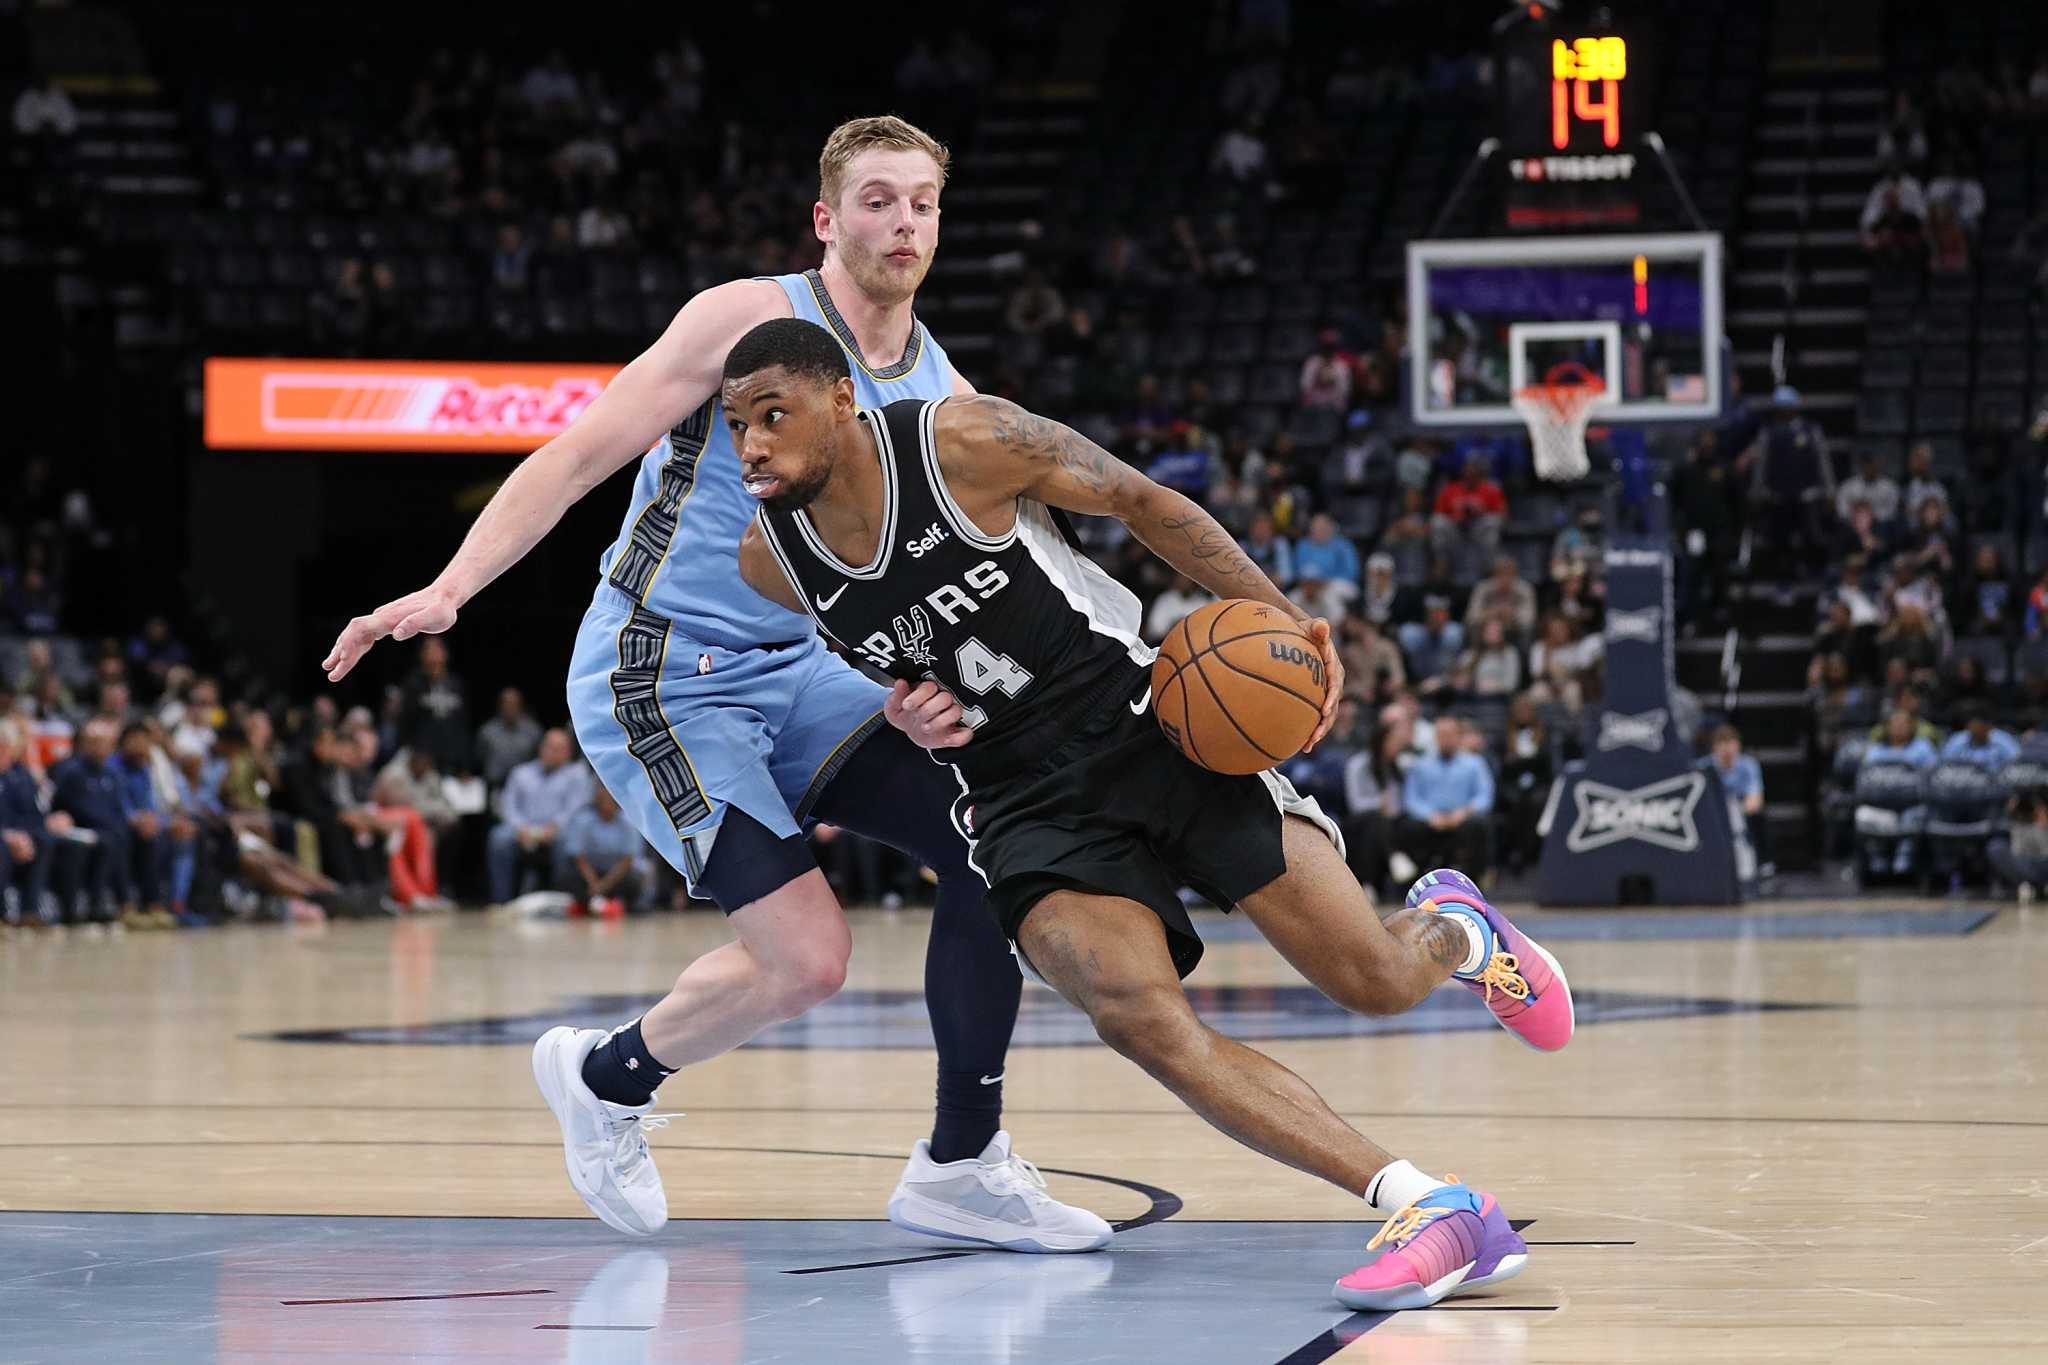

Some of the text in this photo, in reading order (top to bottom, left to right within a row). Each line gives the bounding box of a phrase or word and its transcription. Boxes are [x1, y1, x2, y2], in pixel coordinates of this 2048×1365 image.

[1552, 80, 1619, 149] 14
[433, 381, 602, 431] AutoZ
[906, 522, 949, 558] Self.
